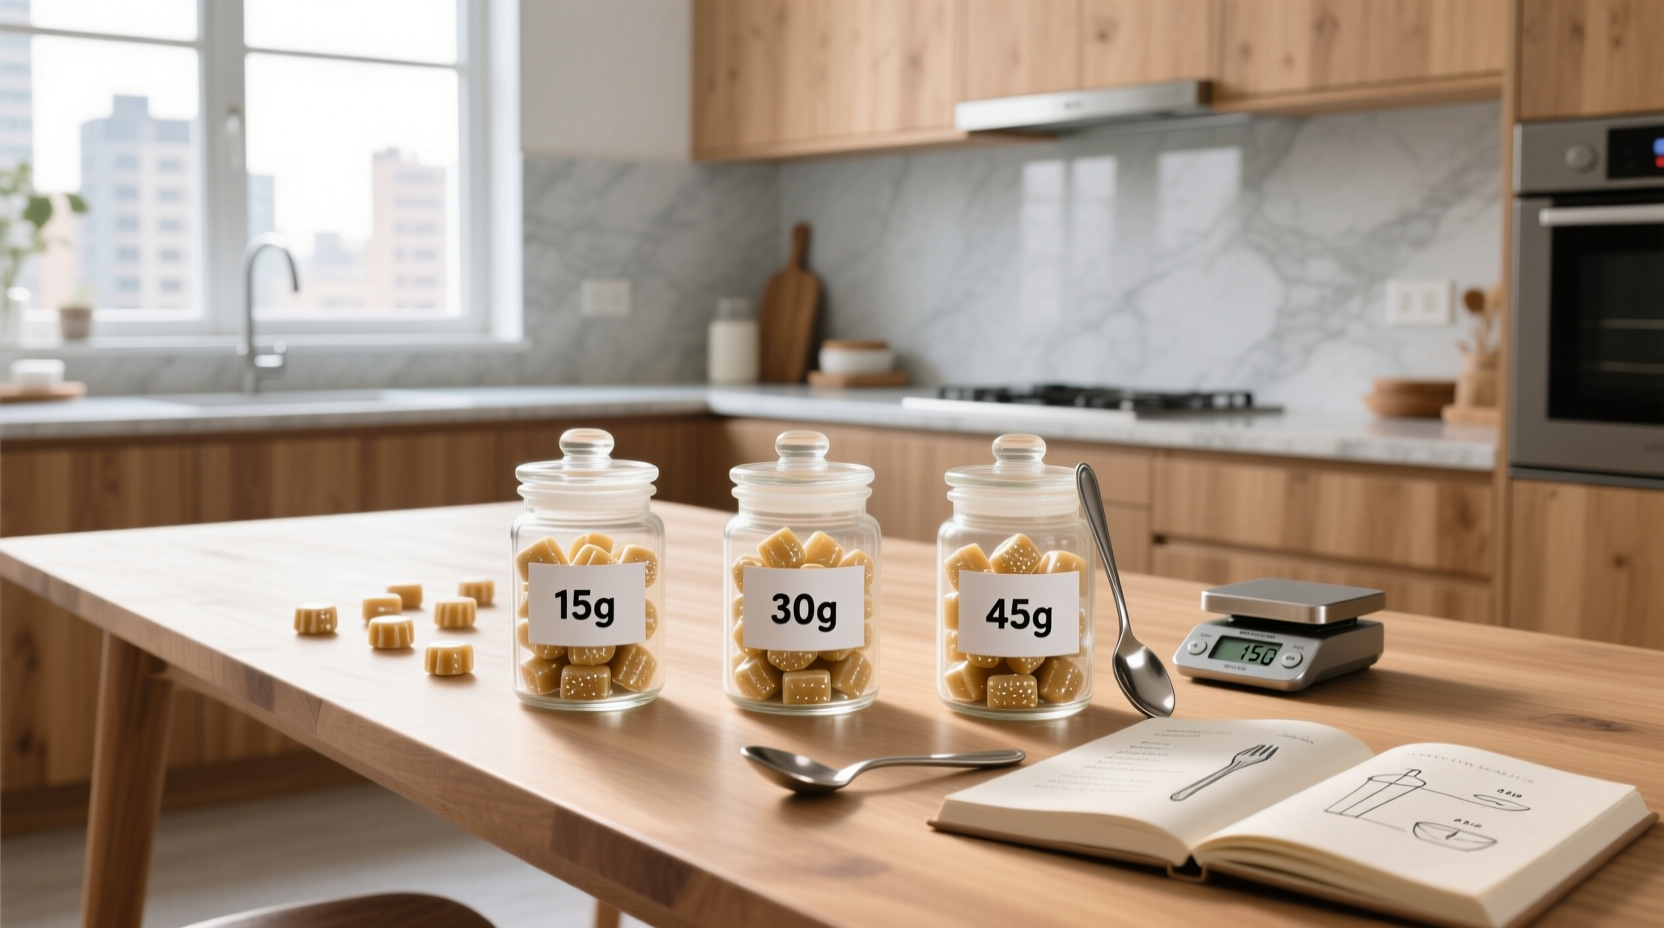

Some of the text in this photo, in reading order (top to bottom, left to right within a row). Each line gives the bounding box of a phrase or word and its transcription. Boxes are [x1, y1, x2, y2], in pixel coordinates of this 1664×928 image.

[555, 590, 615, 628] 15g
[771, 593, 837, 632] 30g
[986, 599, 1052, 638] 45g
[1241, 644, 1278, 666] 150
